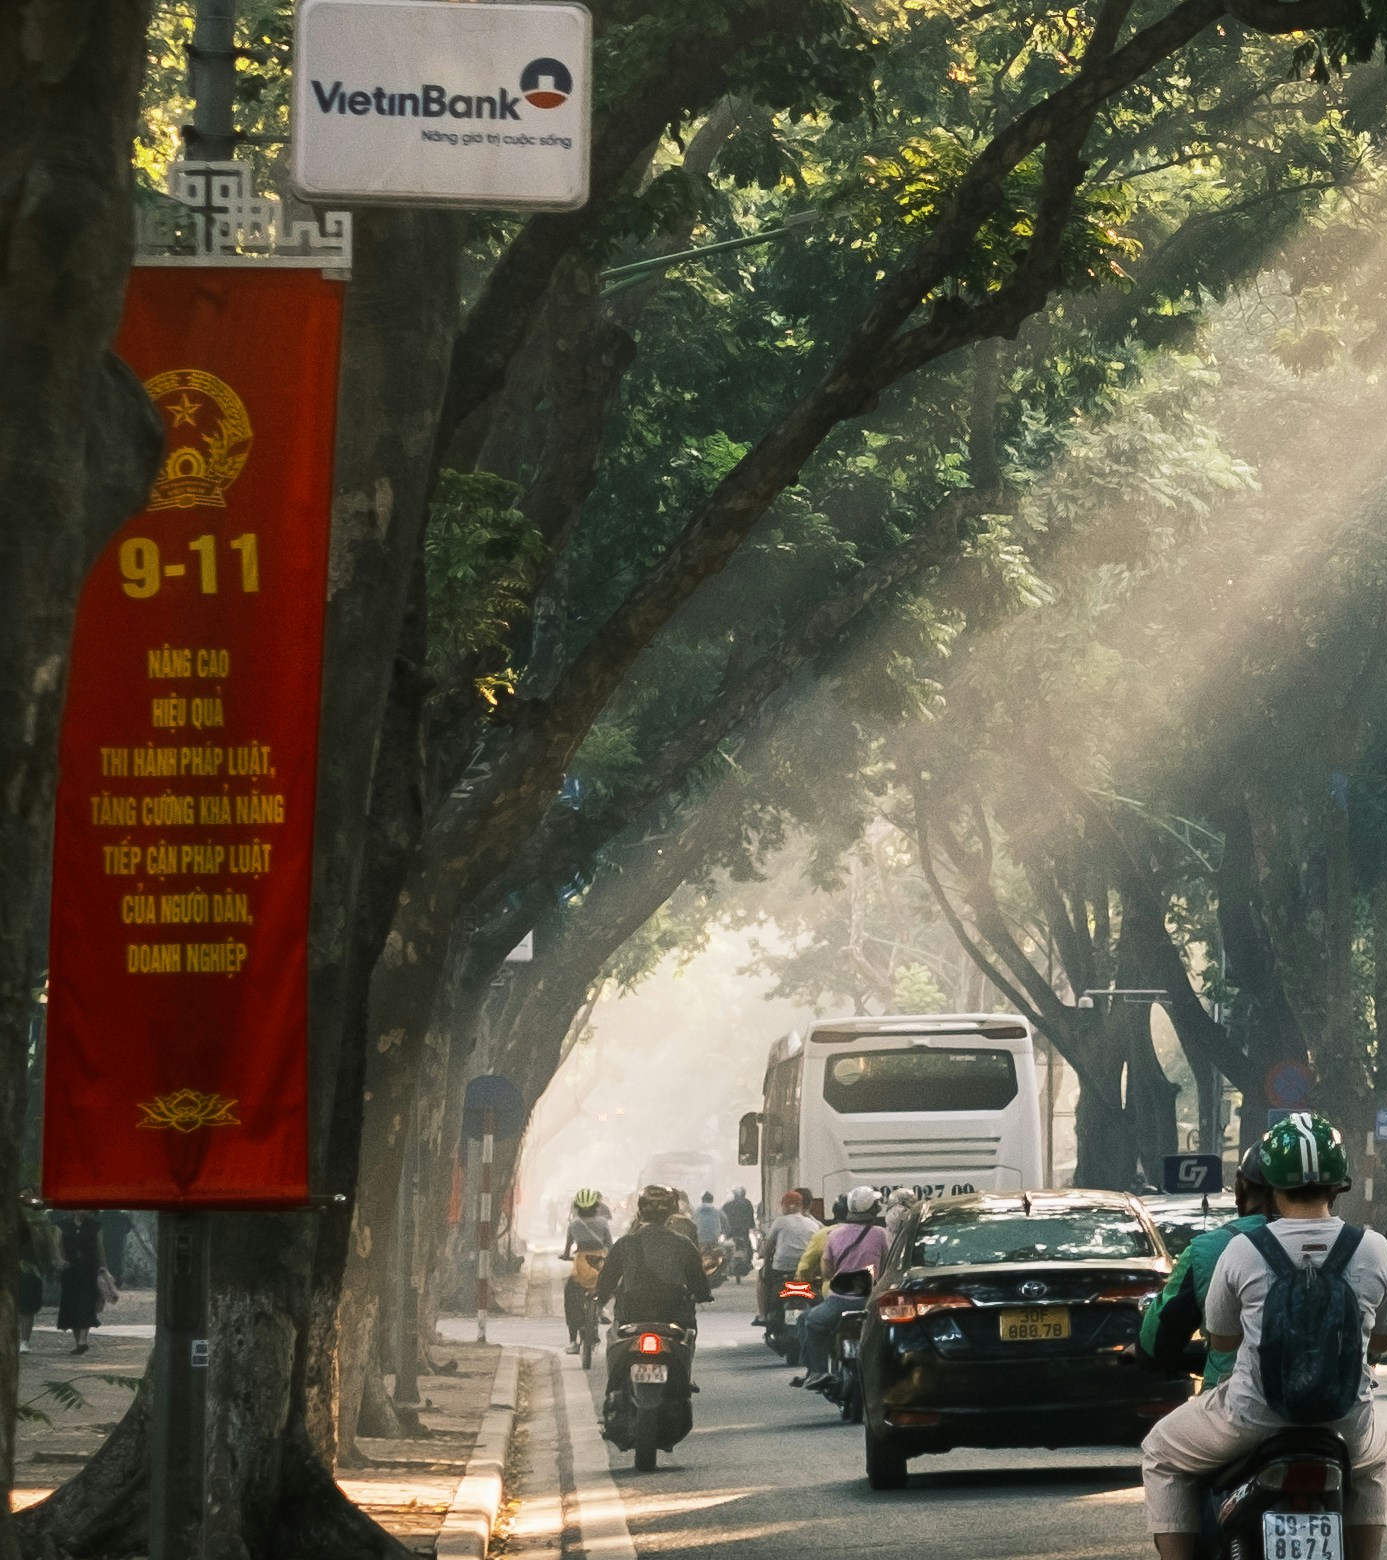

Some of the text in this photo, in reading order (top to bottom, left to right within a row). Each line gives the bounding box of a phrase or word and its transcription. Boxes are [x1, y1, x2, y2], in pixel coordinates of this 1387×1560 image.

[310, 80, 521, 121] VietinBank
[120, 533, 259, 599] 9-11
[148, 643, 230, 678] NÂNG CAO
[152, 686, 224, 733] HIỆU QUẢ
[100, 740, 276, 781] THI HÀNH PHÁP LUẬT,
[90, 784, 285, 826] TĂNG CƯỜNG KHẢ NĂNG
[103, 836, 272, 881] TIẾP CẬN PHÁP LUẬT
[122, 882, 254, 926] CỦA NGƯỜI DÂN,
[128, 937, 247, 978] DOANH NGHIỆP
